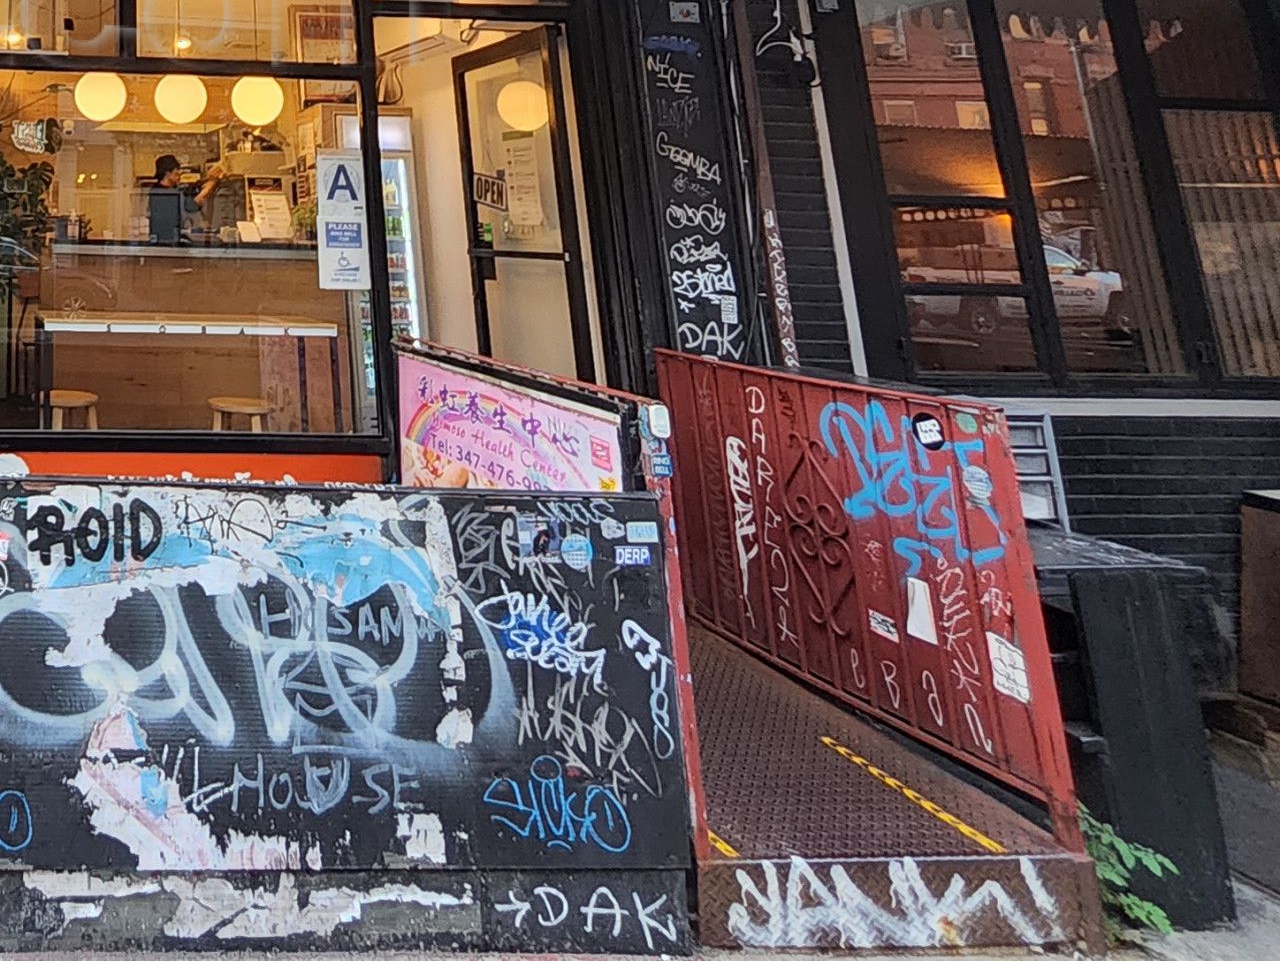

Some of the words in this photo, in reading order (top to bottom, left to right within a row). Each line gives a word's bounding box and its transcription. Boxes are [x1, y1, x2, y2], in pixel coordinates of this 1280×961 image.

[326, 163, 359, 202] A
[475, 175, 505, 208] OPEN
[429, 434, 453, 457] Tel:
[471, 429, 515, 462] Health
[520, 449, 567, 483] Center
[615, 547, 651, 566] DERP
